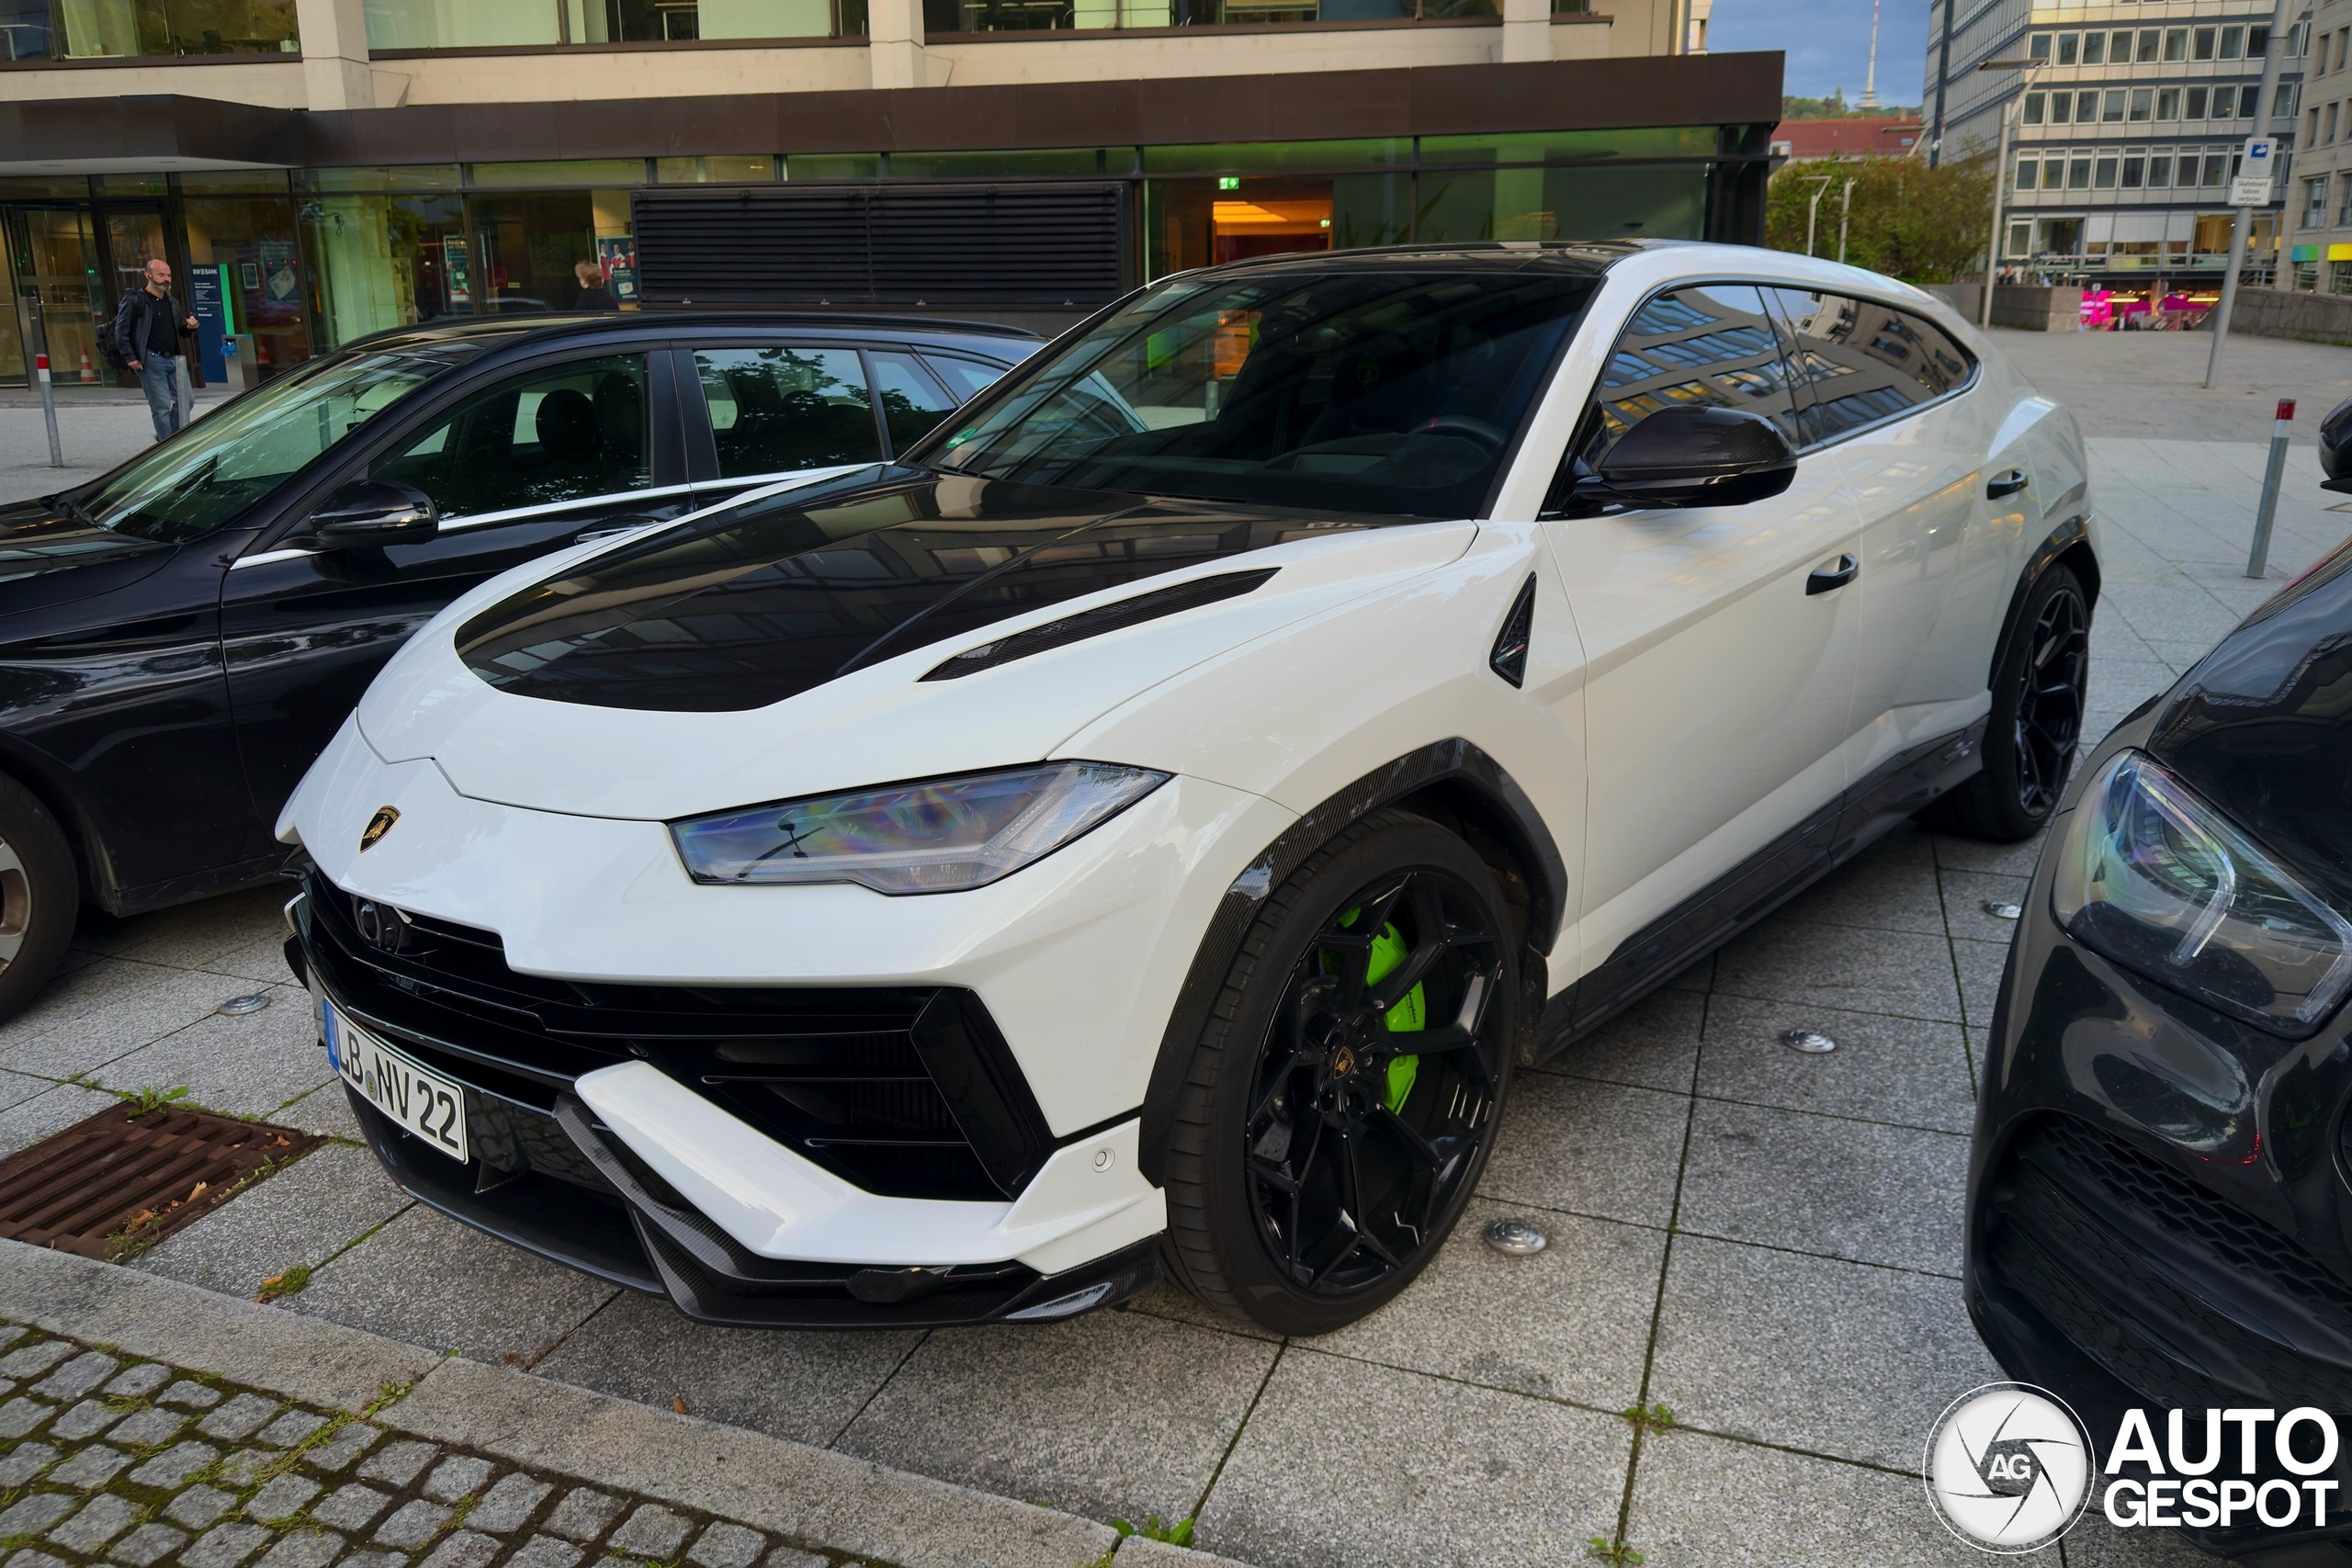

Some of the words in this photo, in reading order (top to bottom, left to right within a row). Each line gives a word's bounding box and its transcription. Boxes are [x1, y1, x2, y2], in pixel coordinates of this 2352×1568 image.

[334, 1018, 364, 1085] LB
[375, 1052, 410, 1120] NV
[417, 1079, 459, 1150] 22
